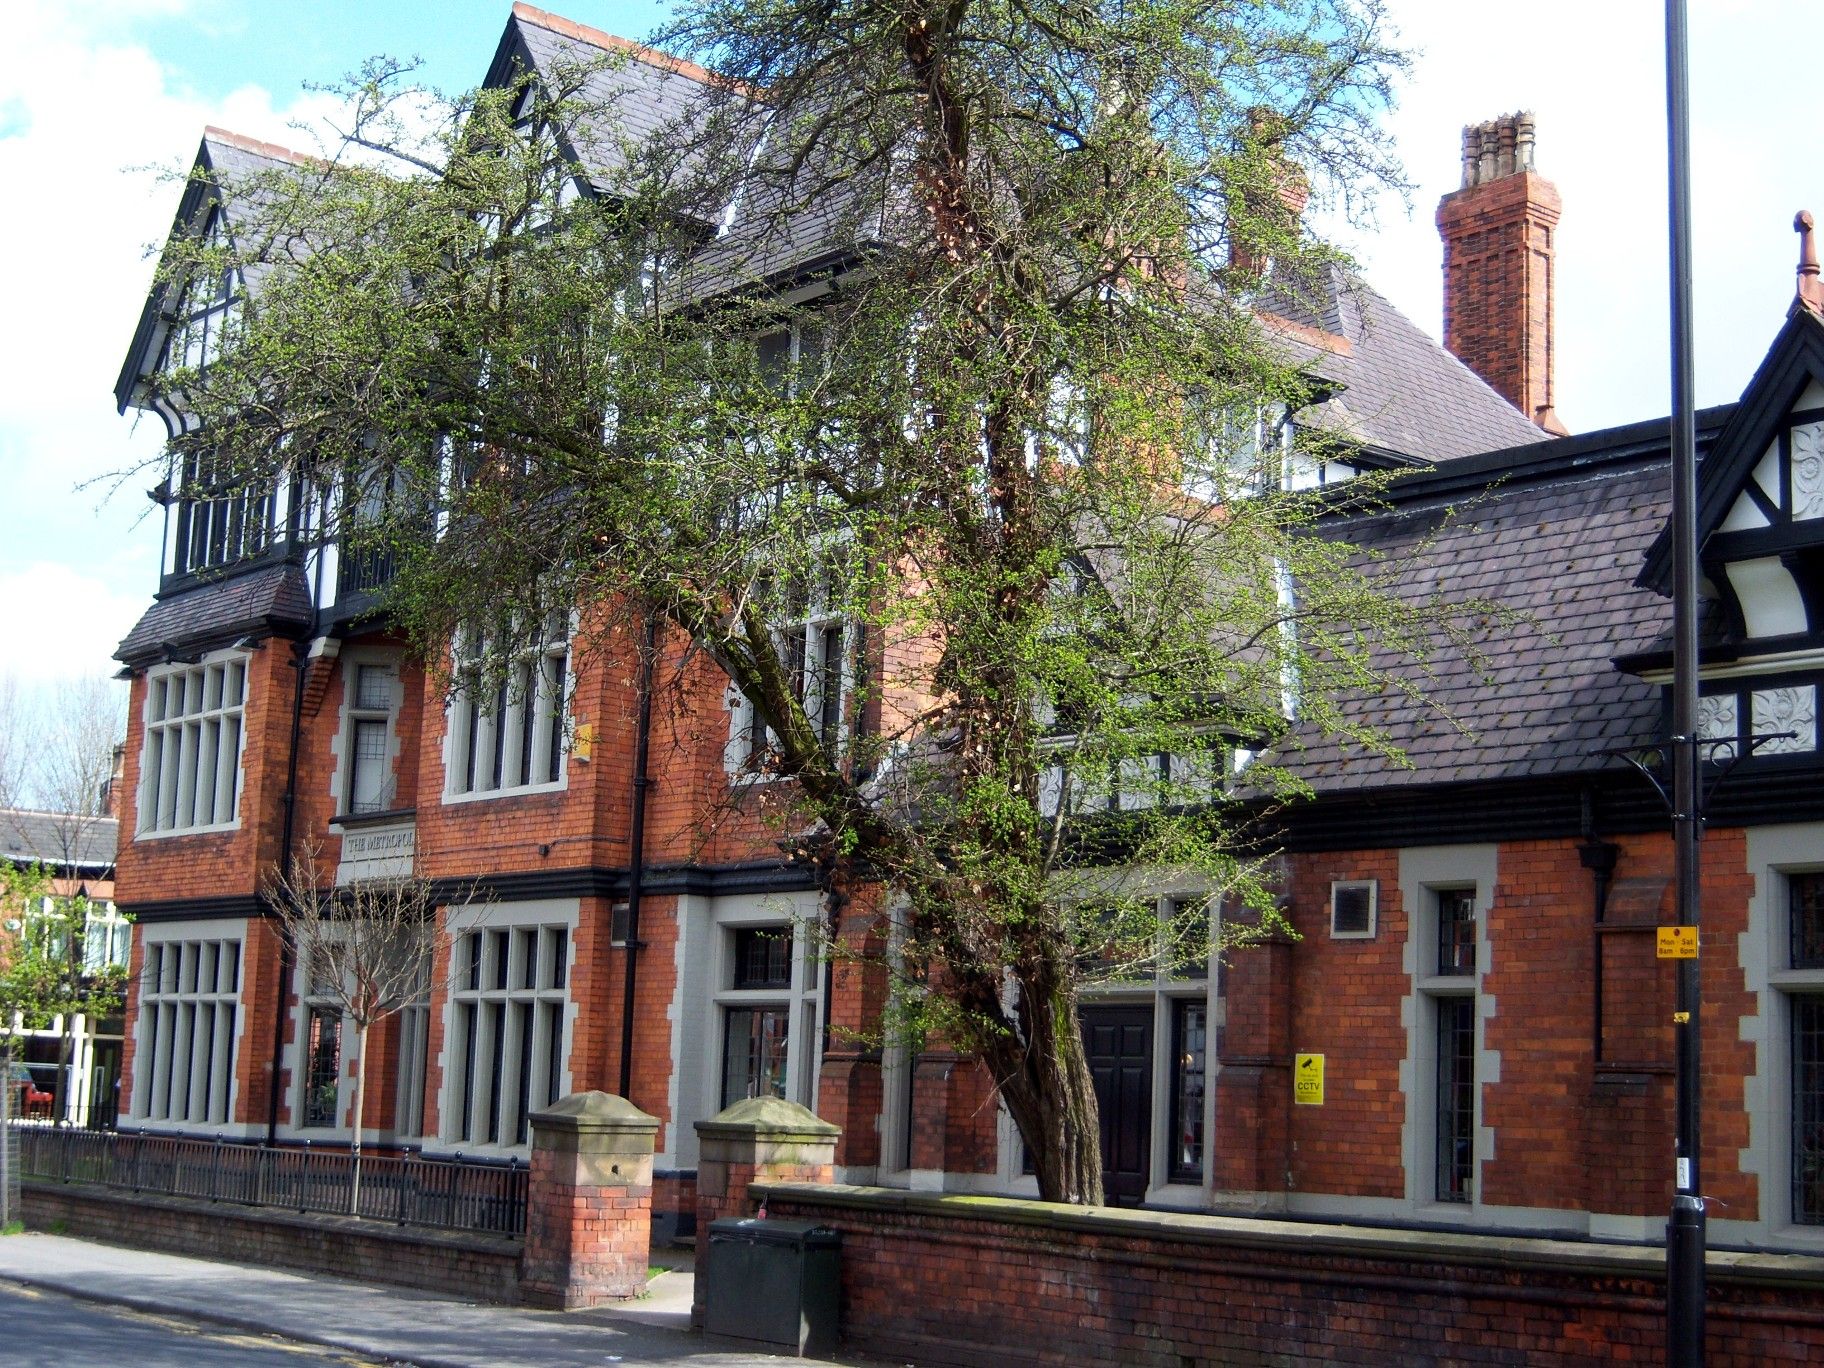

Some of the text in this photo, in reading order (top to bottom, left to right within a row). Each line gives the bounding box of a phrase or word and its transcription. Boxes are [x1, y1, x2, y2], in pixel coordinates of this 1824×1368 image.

[348, 838, 366, 853] THE
[1660, 938, 1675, 946] Mon
[1681, 938, 1694, 946] Sat
[1680, 947, 1695, 956] 6pm
[1297, 1082, 1321, 1090] CCTV
